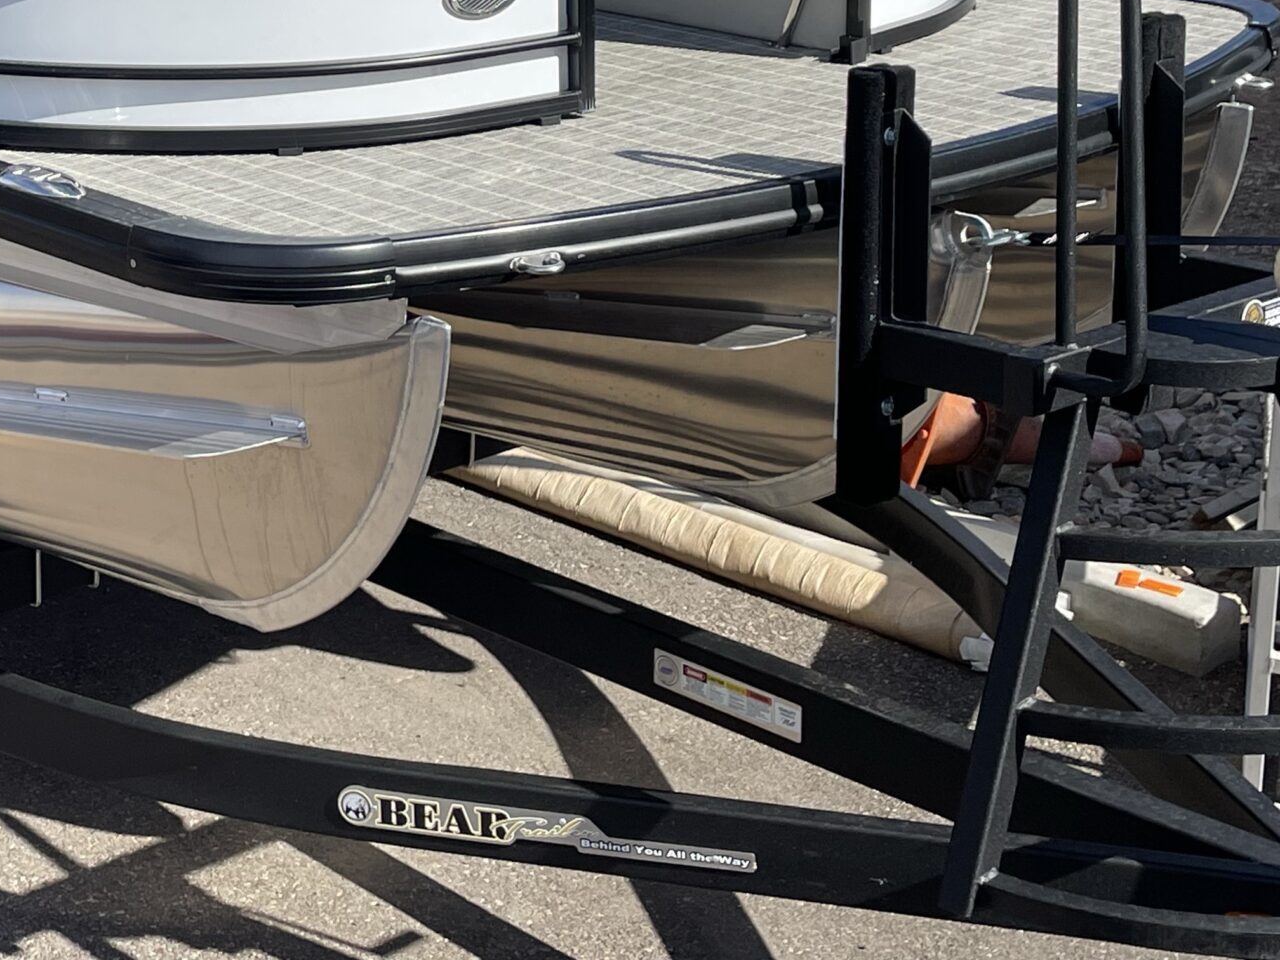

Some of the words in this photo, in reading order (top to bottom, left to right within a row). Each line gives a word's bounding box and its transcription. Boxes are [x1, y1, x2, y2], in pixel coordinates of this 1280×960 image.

[375, 794, 519, 842] BEAR
[580, 838, 631, 854] Behind
[634, 845, 663, 858] You
[666, 848, 687, 860] All
[690, 852, 714, 864] the
[717, 854, 751, 869] Way
